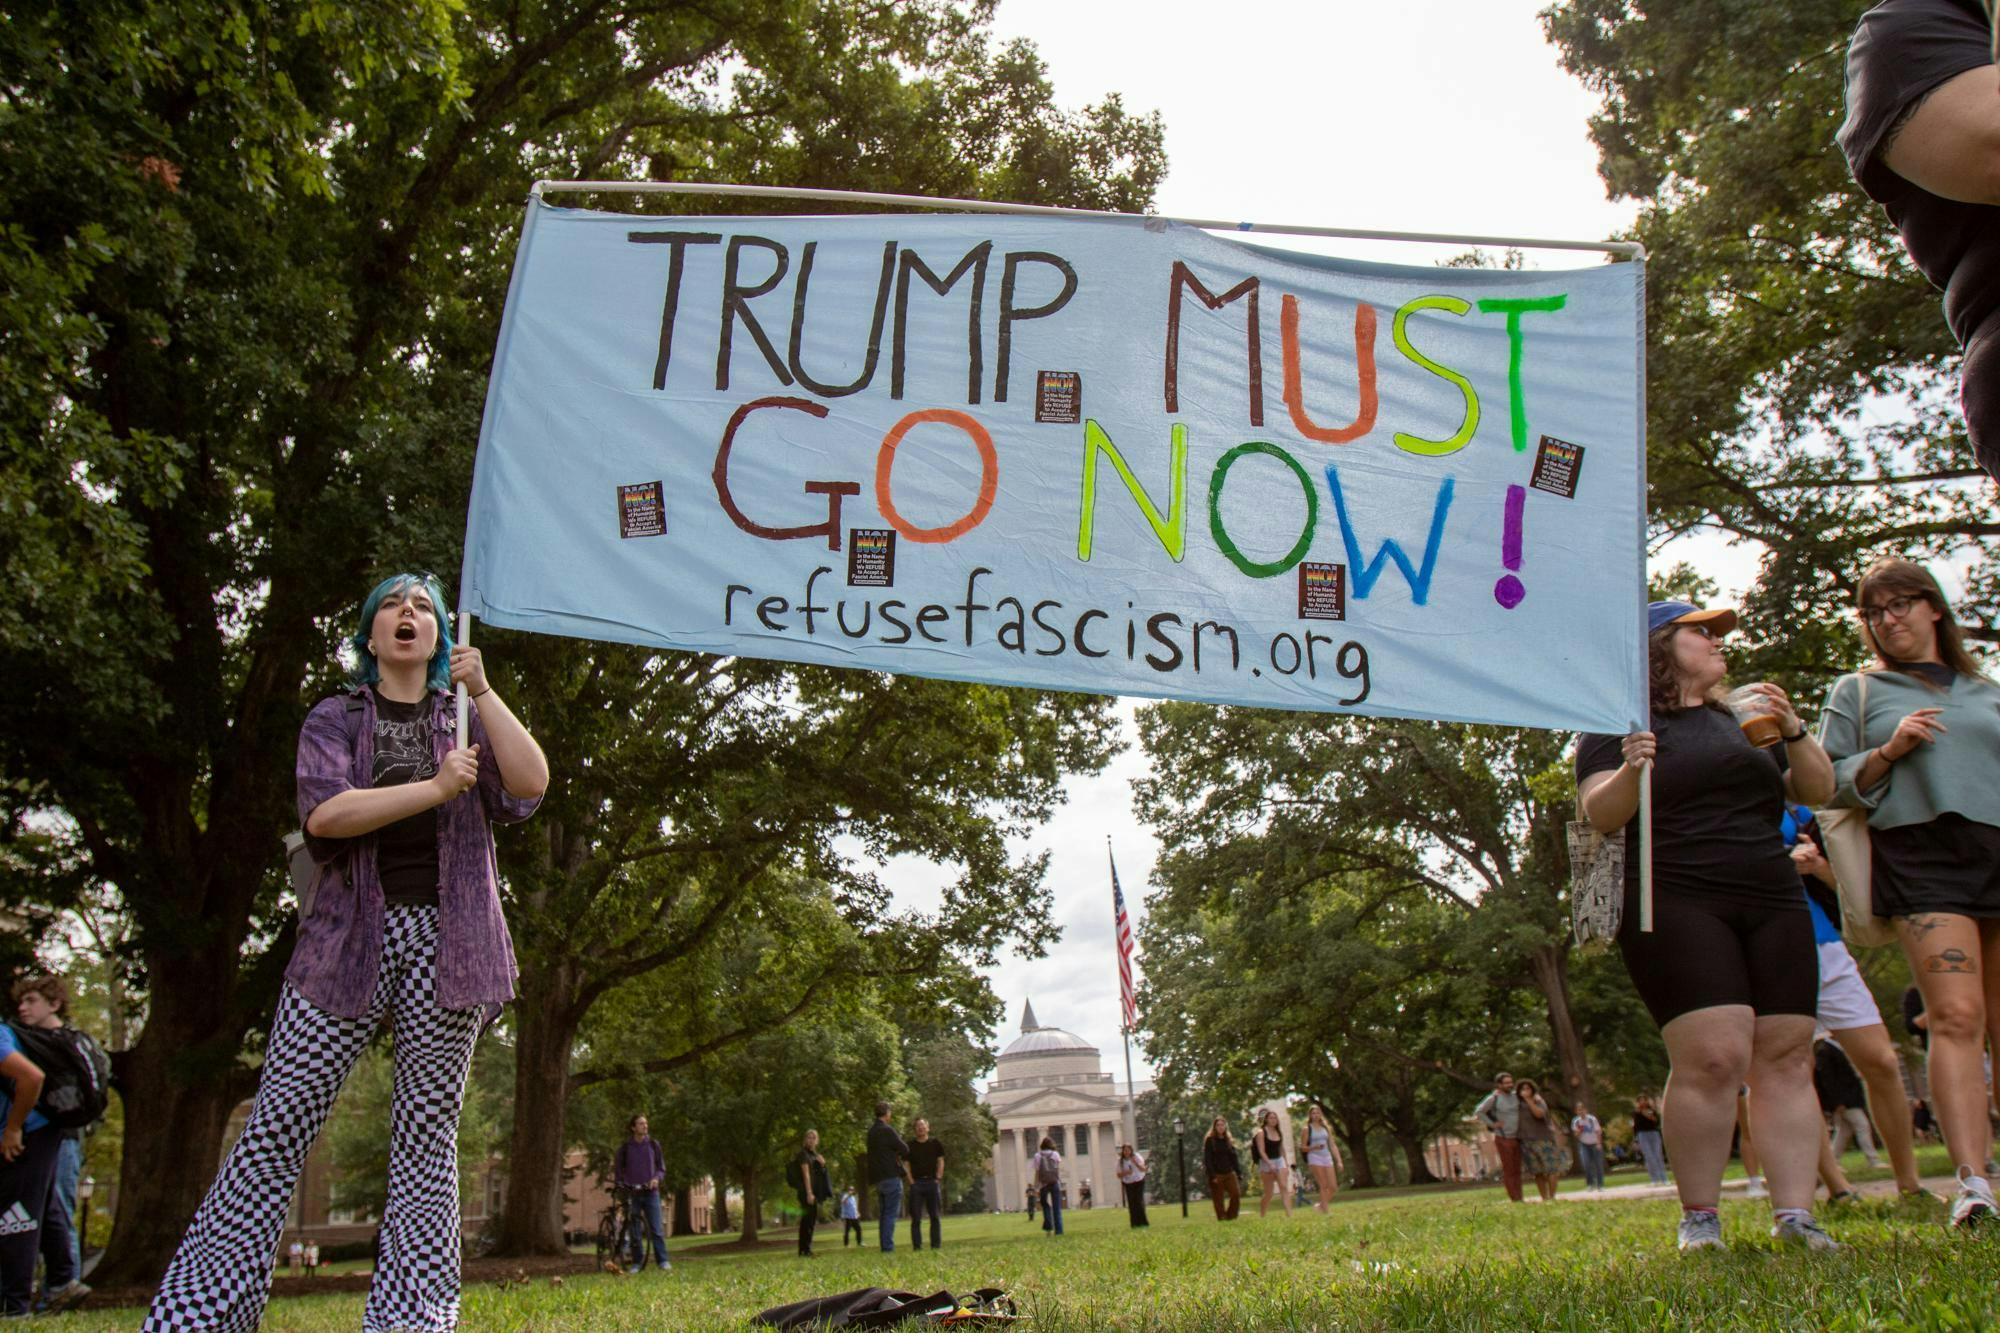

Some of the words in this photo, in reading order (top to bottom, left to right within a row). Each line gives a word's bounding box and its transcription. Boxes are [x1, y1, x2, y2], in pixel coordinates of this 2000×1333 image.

[628, 231, 1078, 405] TRUMP
[1165, 260, 1568, 457] MUST
[1544, 439, 1578, 465] NO!
[624, 484, 656, 507] NO!
[1552, 481, 1571, 491] America
[711, 396, 999, 550] GO
[1077, 419, 1526, 609] NOW!
[856, 531, 888, 553] NO!
[1306, 564, 1337, 587] NO!
[725, 566, 1370, 706] refusefascism.org
[0, 1219, 38, 1235] didas
